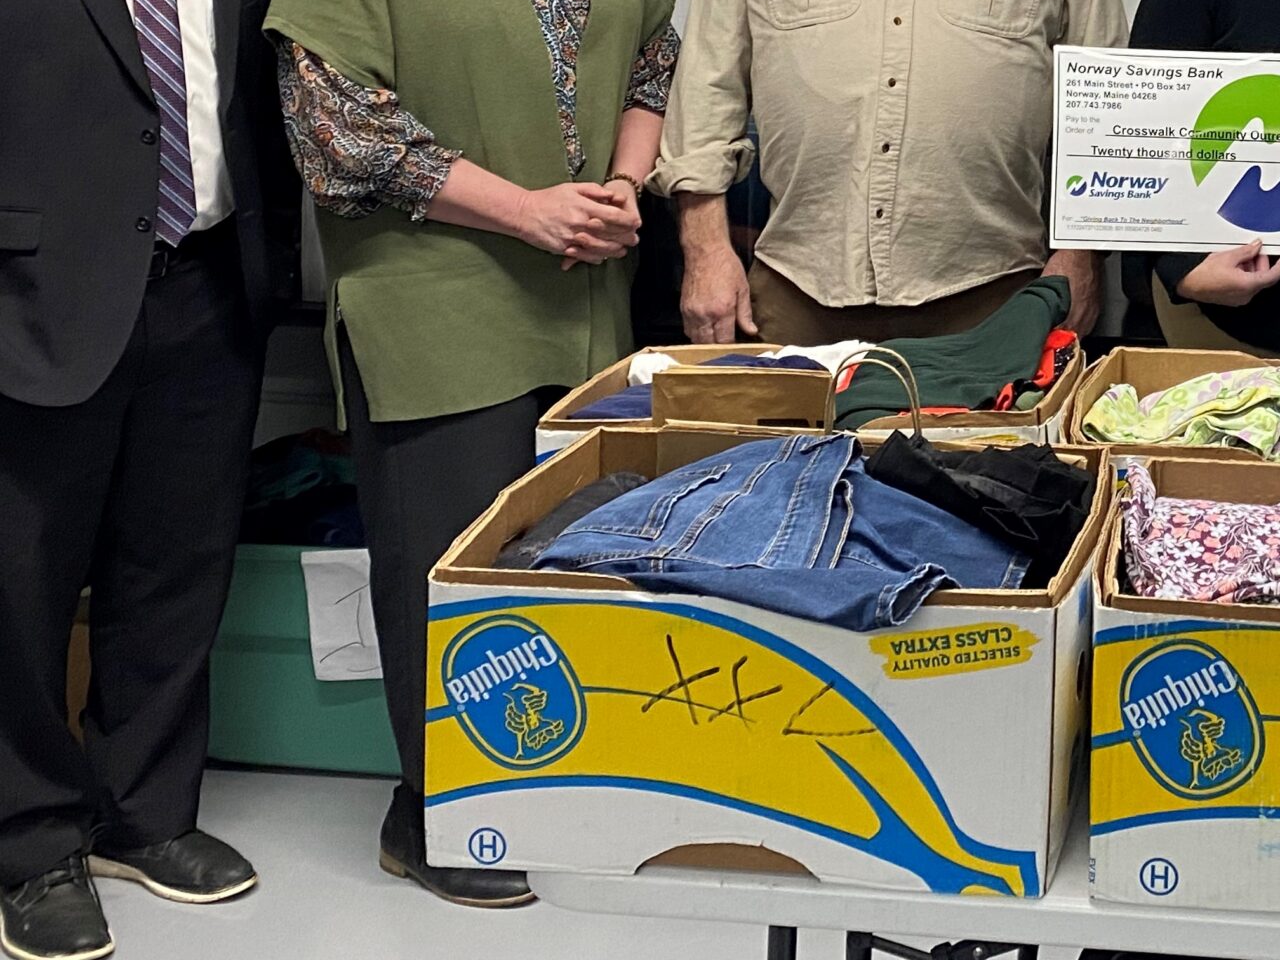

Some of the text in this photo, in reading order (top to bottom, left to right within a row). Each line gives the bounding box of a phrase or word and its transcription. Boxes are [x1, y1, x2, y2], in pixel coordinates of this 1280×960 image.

[1066, 61, 1224, 80] Norway Savings Bank
[1066, 79, 1191, 91] 261 Main Street PO Box 347
[1066, 90, 1157, 101] Norway, Maine 04268
[1066, 100, 1122, 110] 207.743.7986
[1065, 115, 1079, 124] Pay
[1065, 126, 1085, 134] Order
[1112, 124, 1175, 137] Crosswalk
[1178, 126, 1247, 142] Community
[1091, 145, 1237, 161] Twenty thousand dollars
[1090, 171, 1170, 194] Norway
[1088, 188, 1152, 200] Savings Bank
[890, 626, 1013, 655] CLASS EXTRA
[892, 645, 1021, 673] SELECTED QUALITY
[446, 634, 558, 704] Chiquita
[1123, 660, 1238, 729] Chiquita
